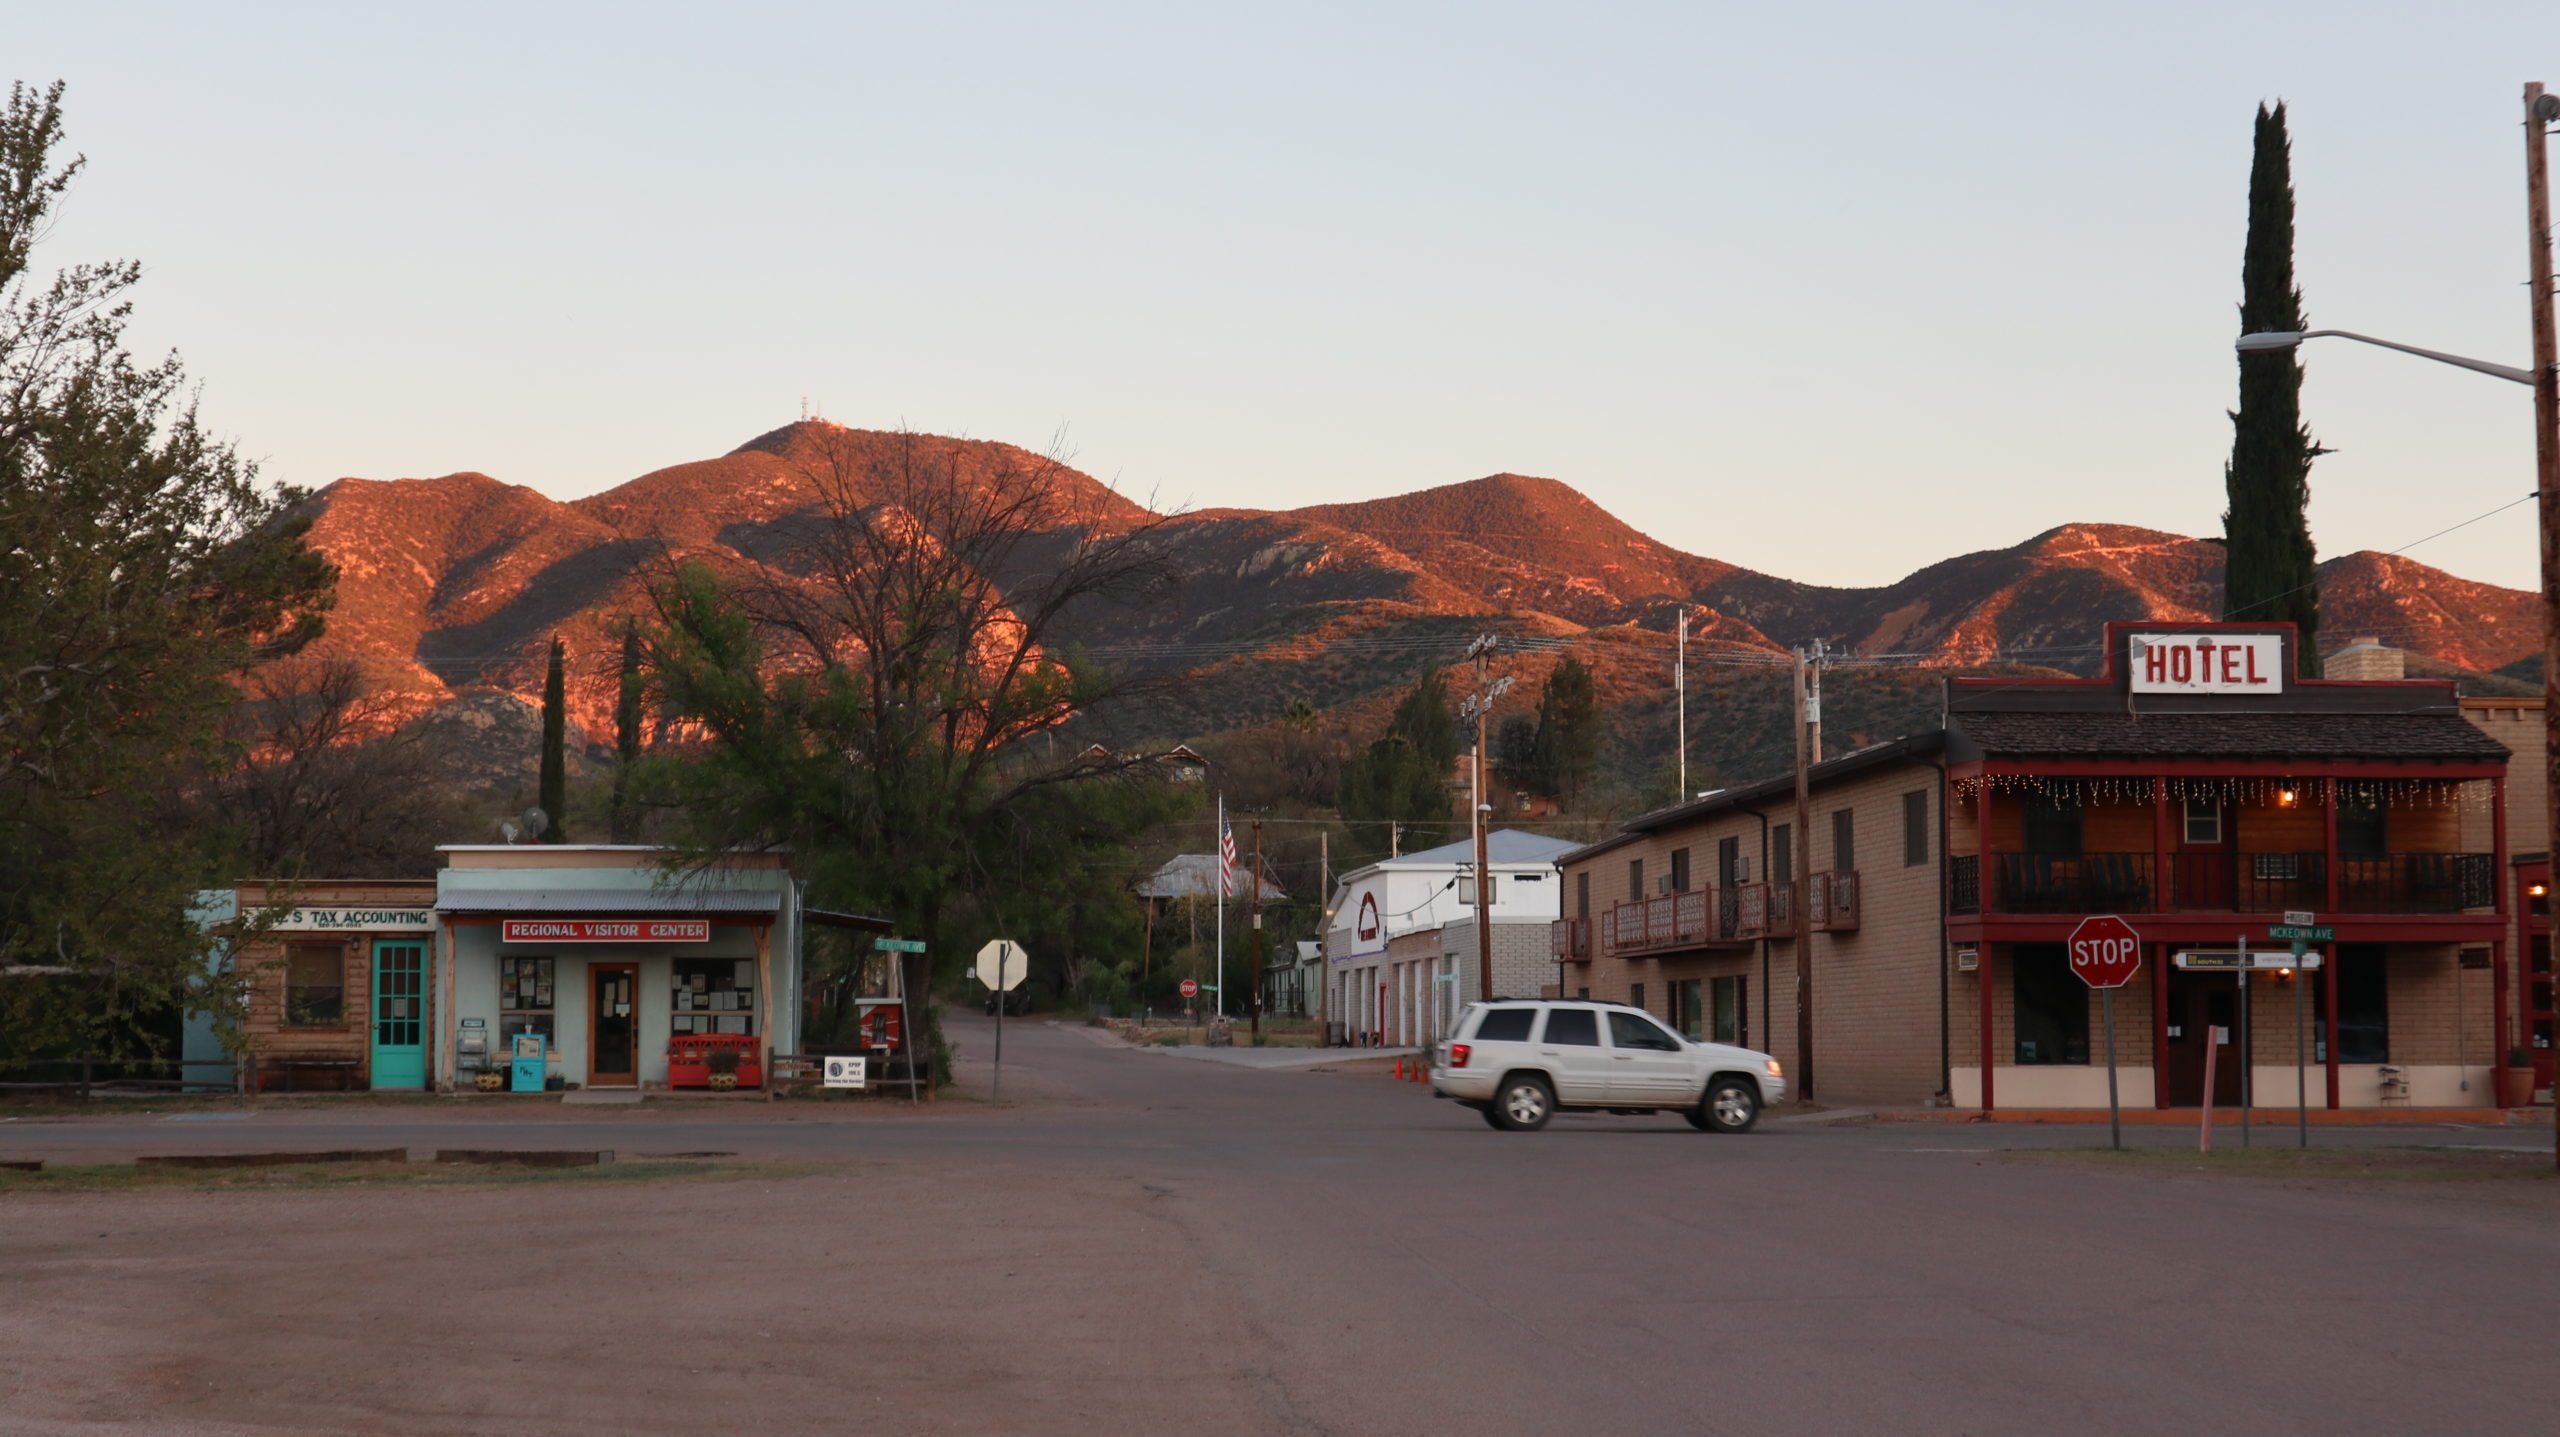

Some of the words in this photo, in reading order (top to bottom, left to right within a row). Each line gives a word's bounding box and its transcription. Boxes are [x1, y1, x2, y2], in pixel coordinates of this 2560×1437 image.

[2145, 645, 2268, 683] HOTEL
[310, 911, 338, 924] TAX
[342, 911, 428, 924] ACCOUNTING
[511, 924, 577, 937] REGIONAL
[585, 924, 639, 937] VISITOR
[649, 924, 705, 937] CENTER
[2269, 928, 2312, 938] MCKEOWN
[2315, 928, 2334, 940] AVE
[2075, 938, 2135, 966] STOP
